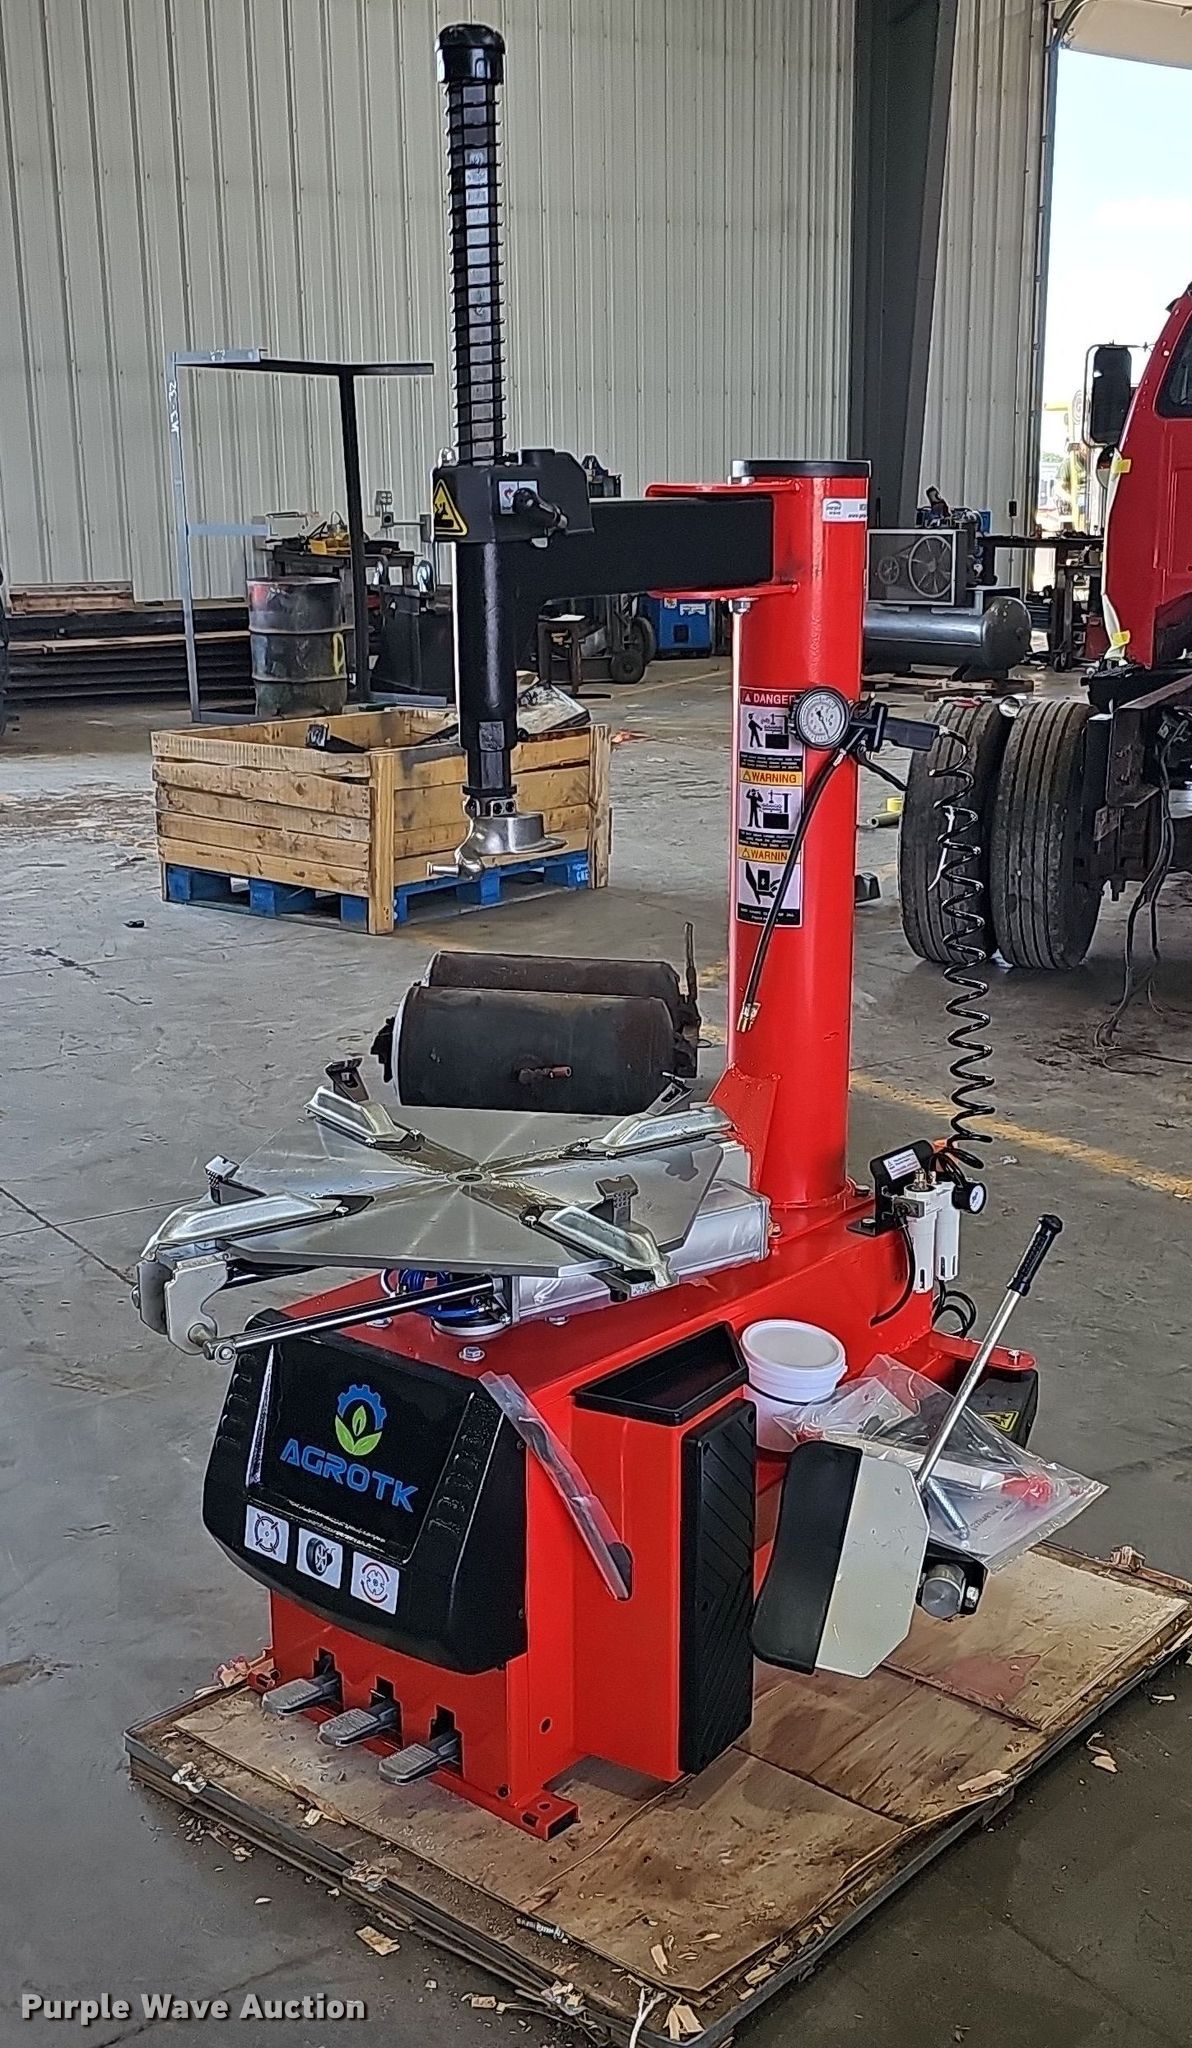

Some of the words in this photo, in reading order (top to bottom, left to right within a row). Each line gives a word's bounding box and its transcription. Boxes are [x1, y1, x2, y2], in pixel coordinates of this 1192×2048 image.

[752, 772, 797, 784] WARNING
[750, 849, 788, 861] WARNIN
[280, 1438, 419, 1513] AGROTK
